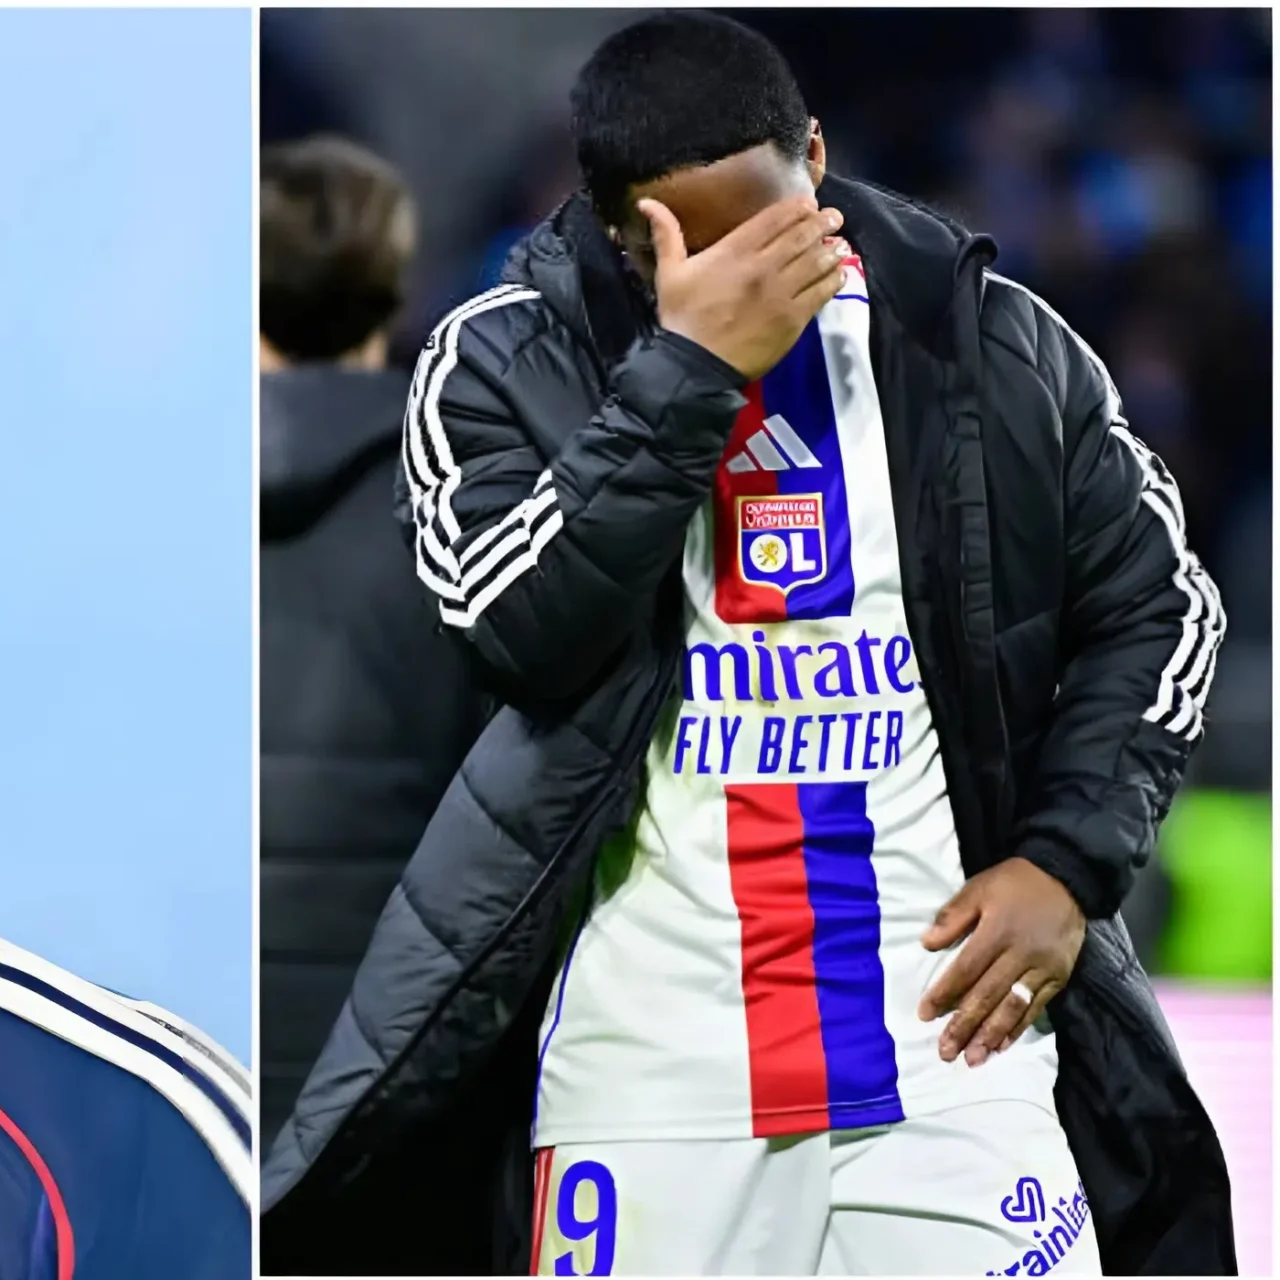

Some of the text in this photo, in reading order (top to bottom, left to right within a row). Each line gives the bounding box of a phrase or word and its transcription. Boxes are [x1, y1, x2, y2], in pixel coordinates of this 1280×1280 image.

[683, 629, 921, 702] mirate
[673, 711, 903, 774] FLY BETTER
[555, 1160, 617, 1276] 9
